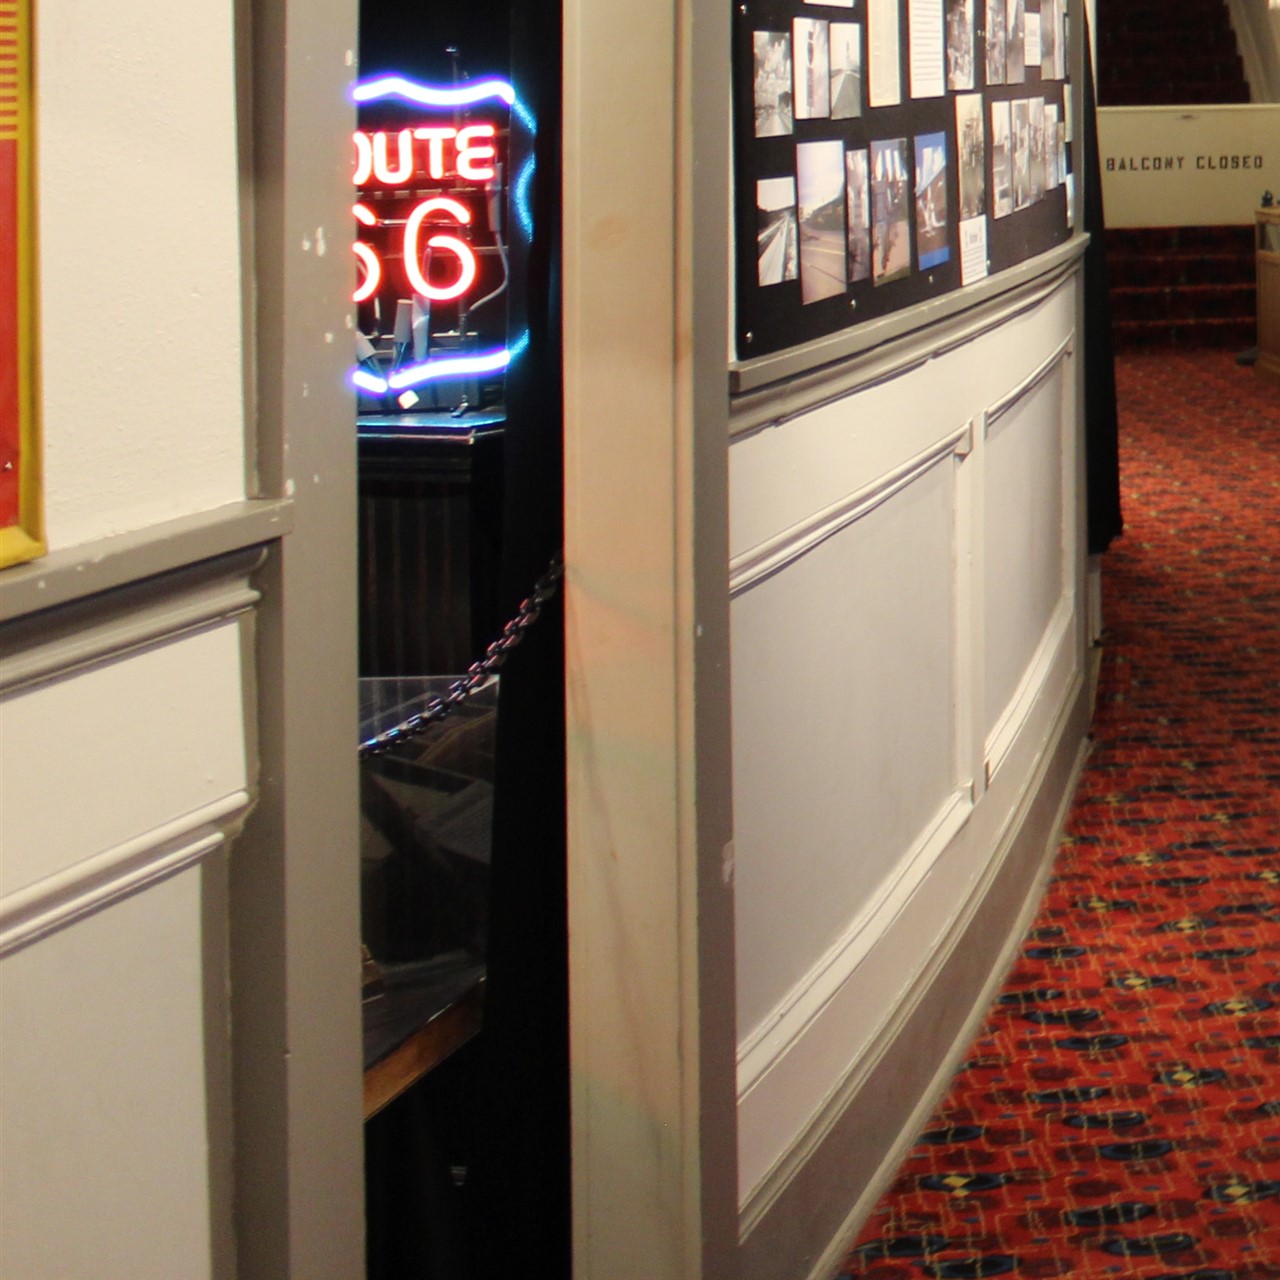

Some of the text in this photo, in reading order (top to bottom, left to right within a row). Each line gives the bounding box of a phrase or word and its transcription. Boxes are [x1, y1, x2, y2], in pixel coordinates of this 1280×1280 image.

[353, 124, 496, 186] OUTE
[1106, 155, 1264, 172] BALCONY CLOSED
